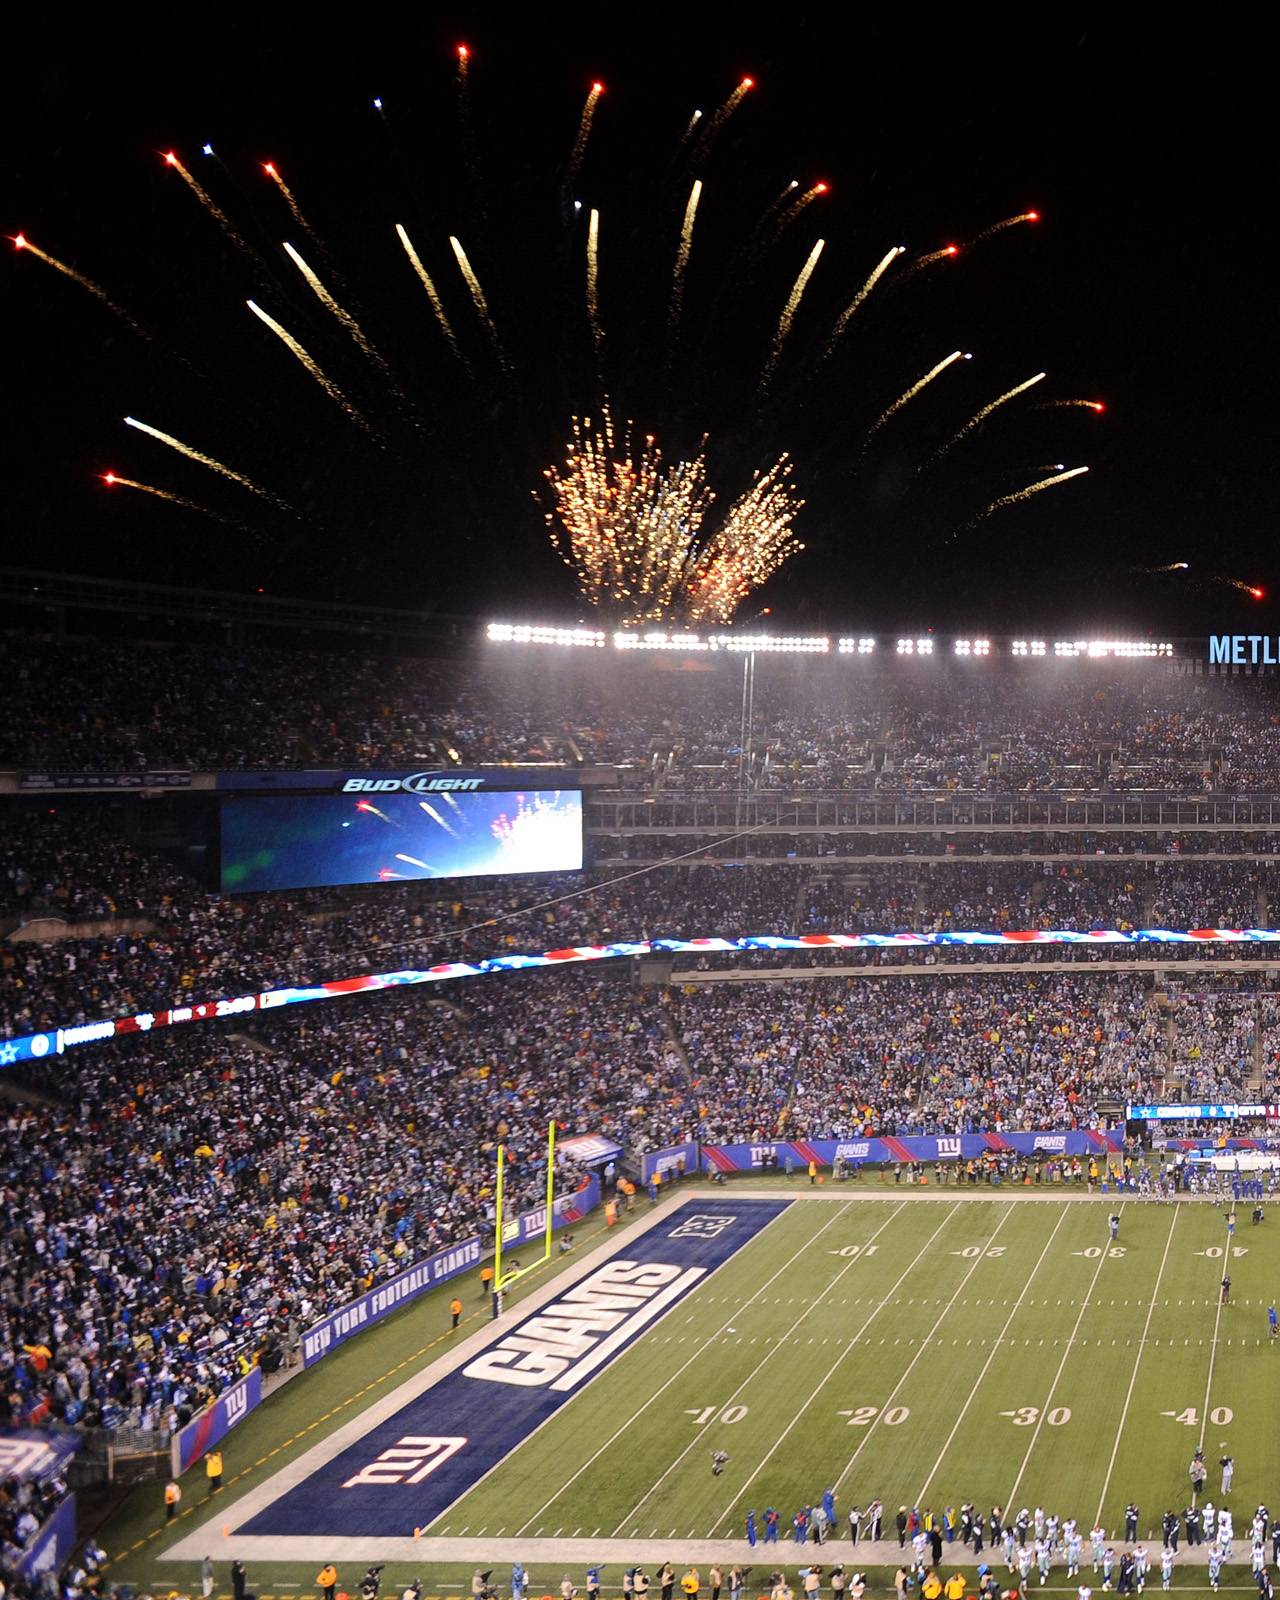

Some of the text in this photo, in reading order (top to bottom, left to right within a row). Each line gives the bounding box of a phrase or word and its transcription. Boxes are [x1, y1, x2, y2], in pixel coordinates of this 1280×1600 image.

[835, 1142, 871, 1157] GIANTS
[1034, 1135, 1066, 1148] GIANTS
[839, 1245, 880, 1257] 10
[960, 1245, 1007, 1258] 20
[1082, 1246, 1127, 1258] 30
[1203, 1246, 1249, 1258] 40
[304, 1241, 480, 1360] NEW YORK FOOTBALL GIANTS
[462, 1260, 684, 1386] GIANTS
[692, 1405, 749, 1425] 10
[847, 1406, 911, 1425] 20
[1011, 1406, 1073, 1426] 30
[1175, 1407, 1234, 1425] 40
